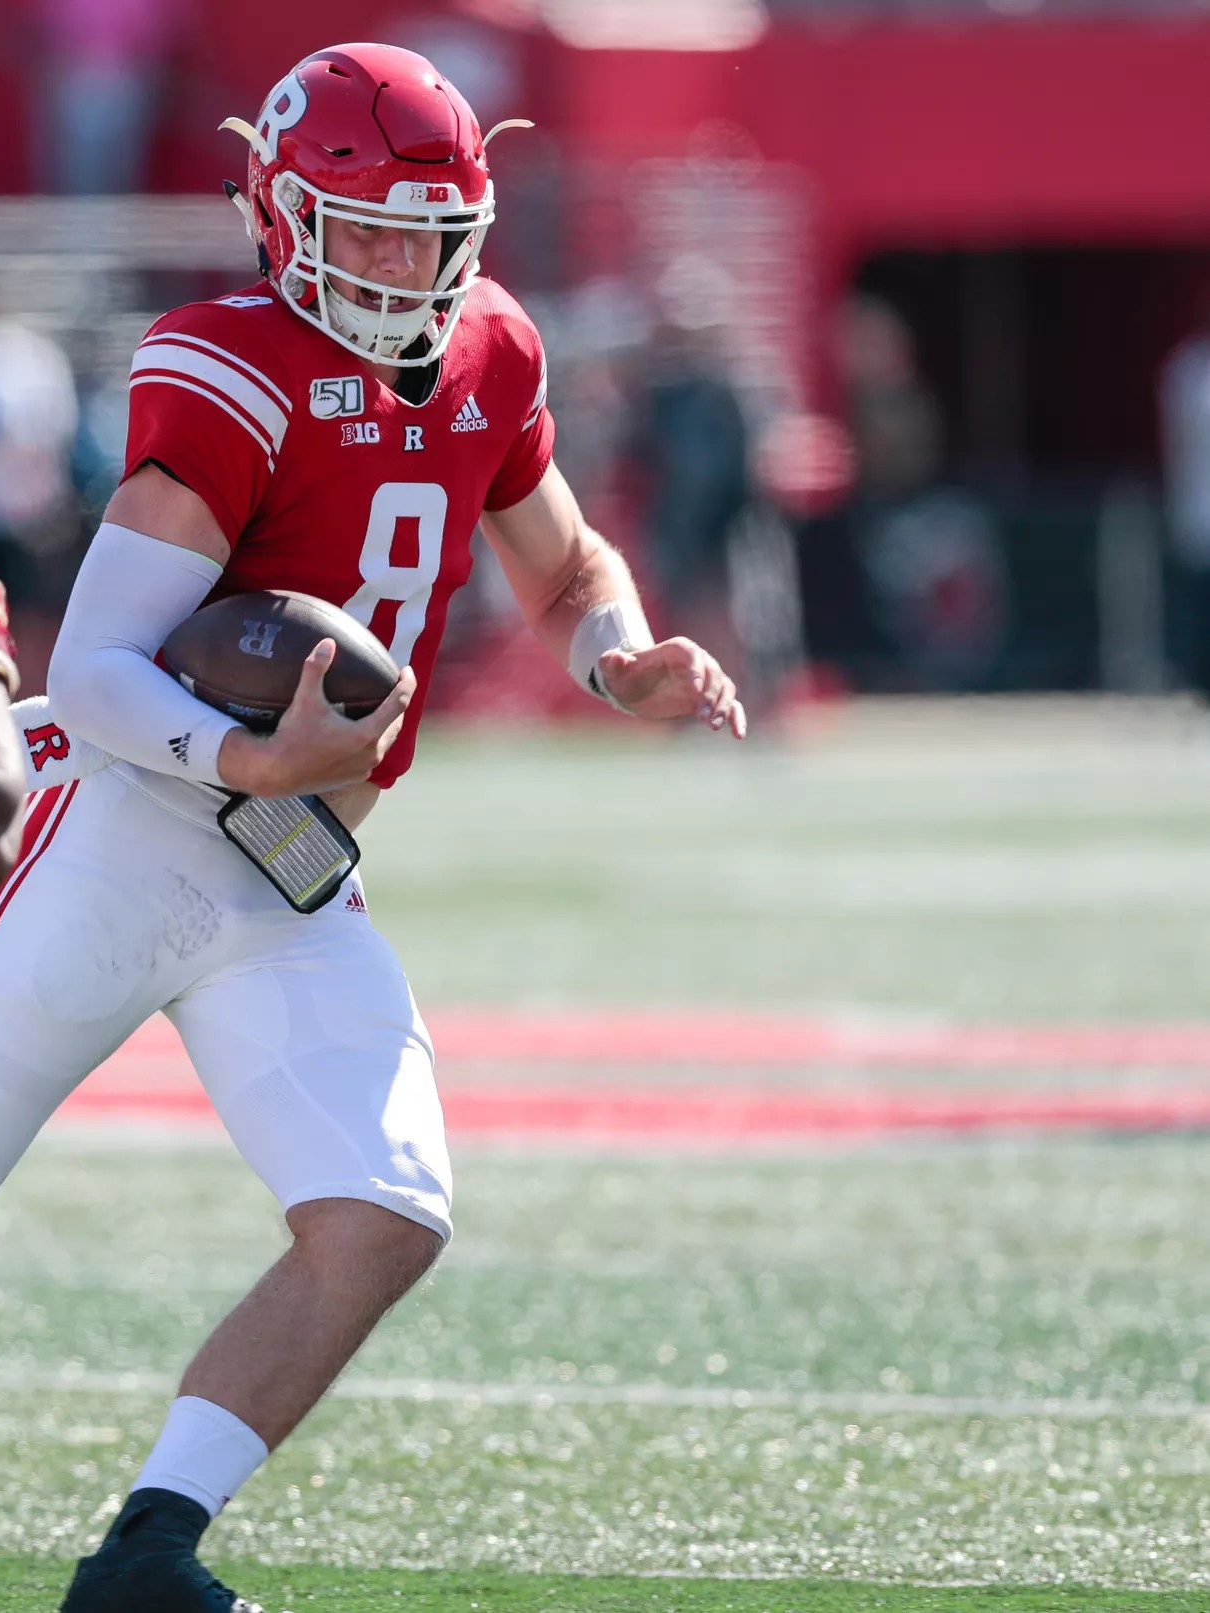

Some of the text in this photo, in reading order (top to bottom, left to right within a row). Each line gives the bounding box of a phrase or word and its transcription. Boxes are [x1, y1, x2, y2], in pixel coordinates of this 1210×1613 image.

[255, 72, 308, 165] R
[404, 425, 425, 451] R
[451, 417, 488, 433] adidas
[341, 482, 449, 668] 8
[238, 619, 283, 659] R
[23, 722, 71, 773] R
